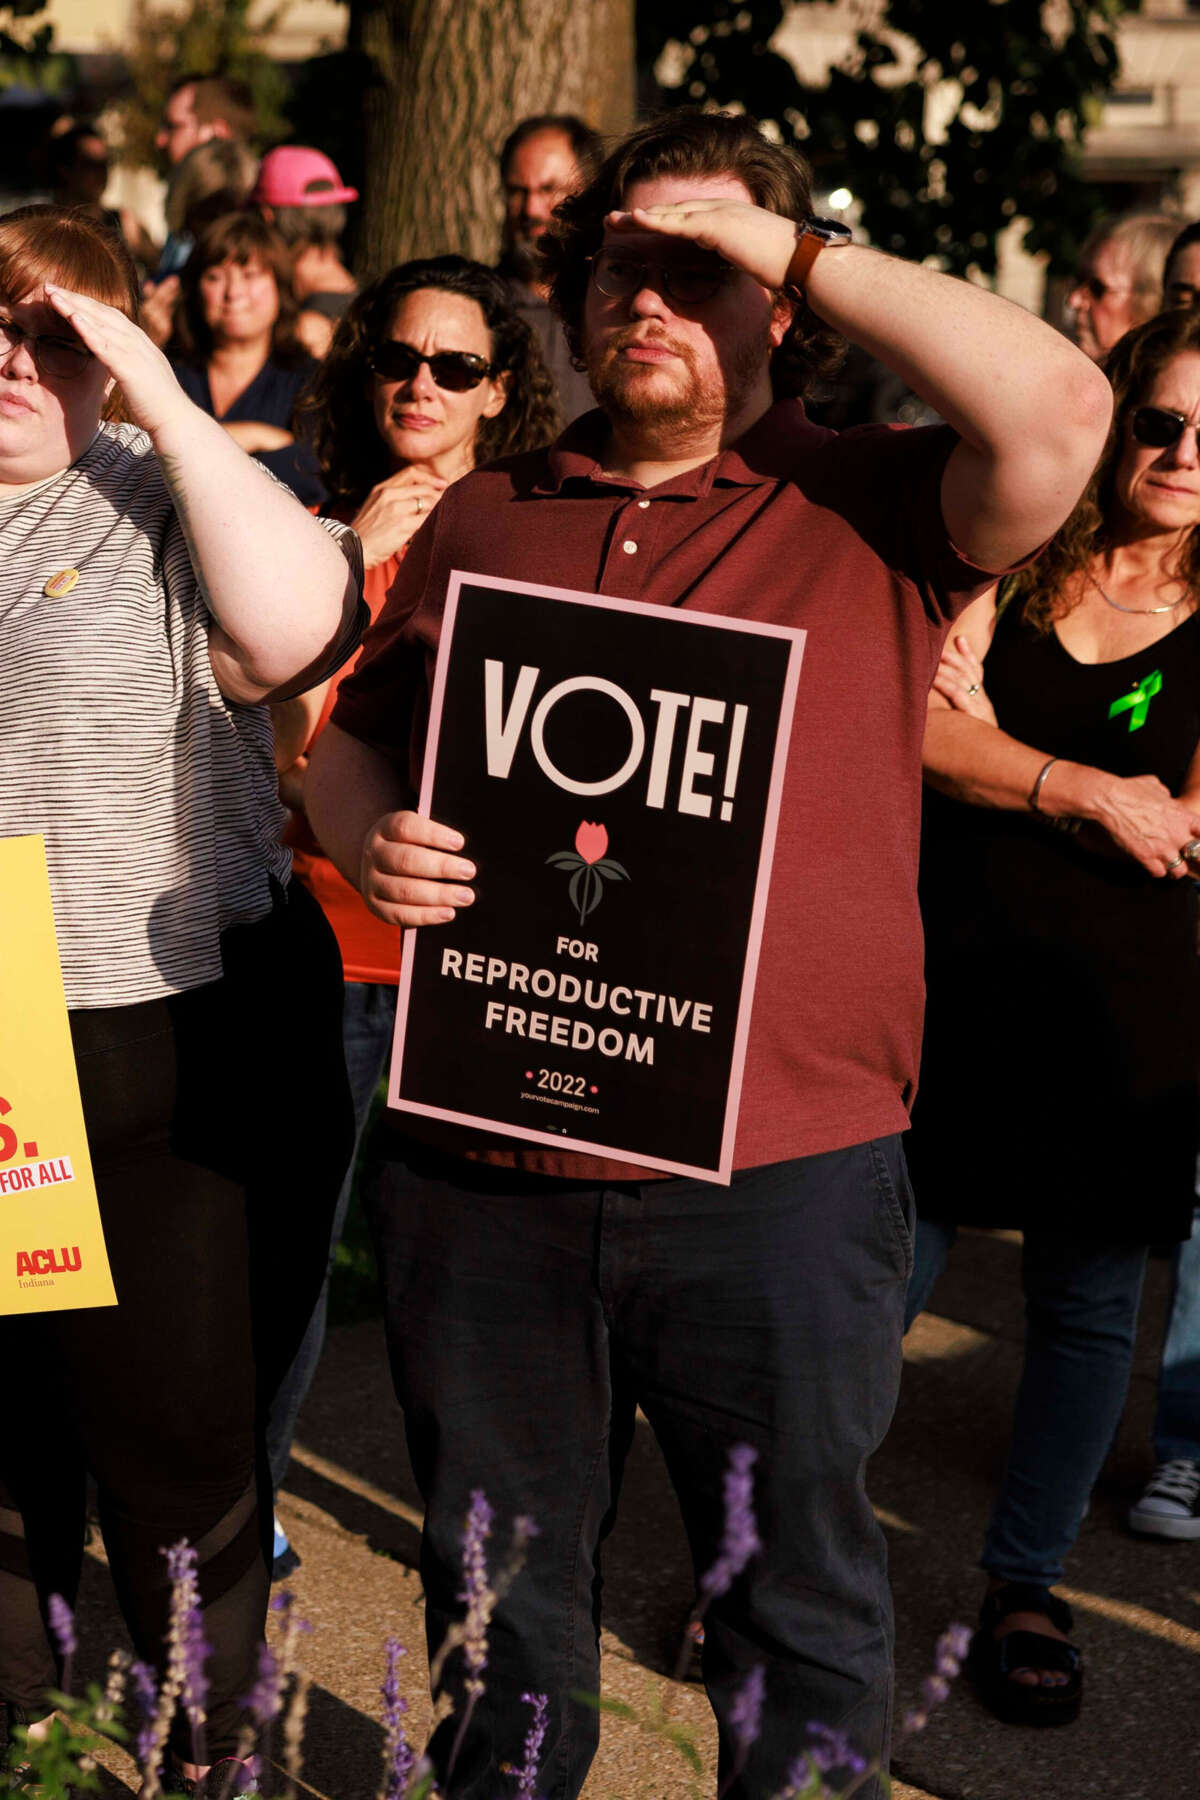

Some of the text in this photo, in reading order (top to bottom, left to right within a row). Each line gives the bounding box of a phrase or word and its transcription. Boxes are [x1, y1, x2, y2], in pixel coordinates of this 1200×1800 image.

[485, 658, 748, 822] VOTE!
[556, 936, 599, 963] FOR
[441, 948, 713, 1033] REPRODUCTIVE
[485, 1001, 655, 1065] FREEDOM
[537, 1069, 586, 1097] 2022
[39, 1159, 73, 1185] ALL
[16, 1246, 83, 1277] ACLU
[17, 1278, 55, 1289] Indiana
